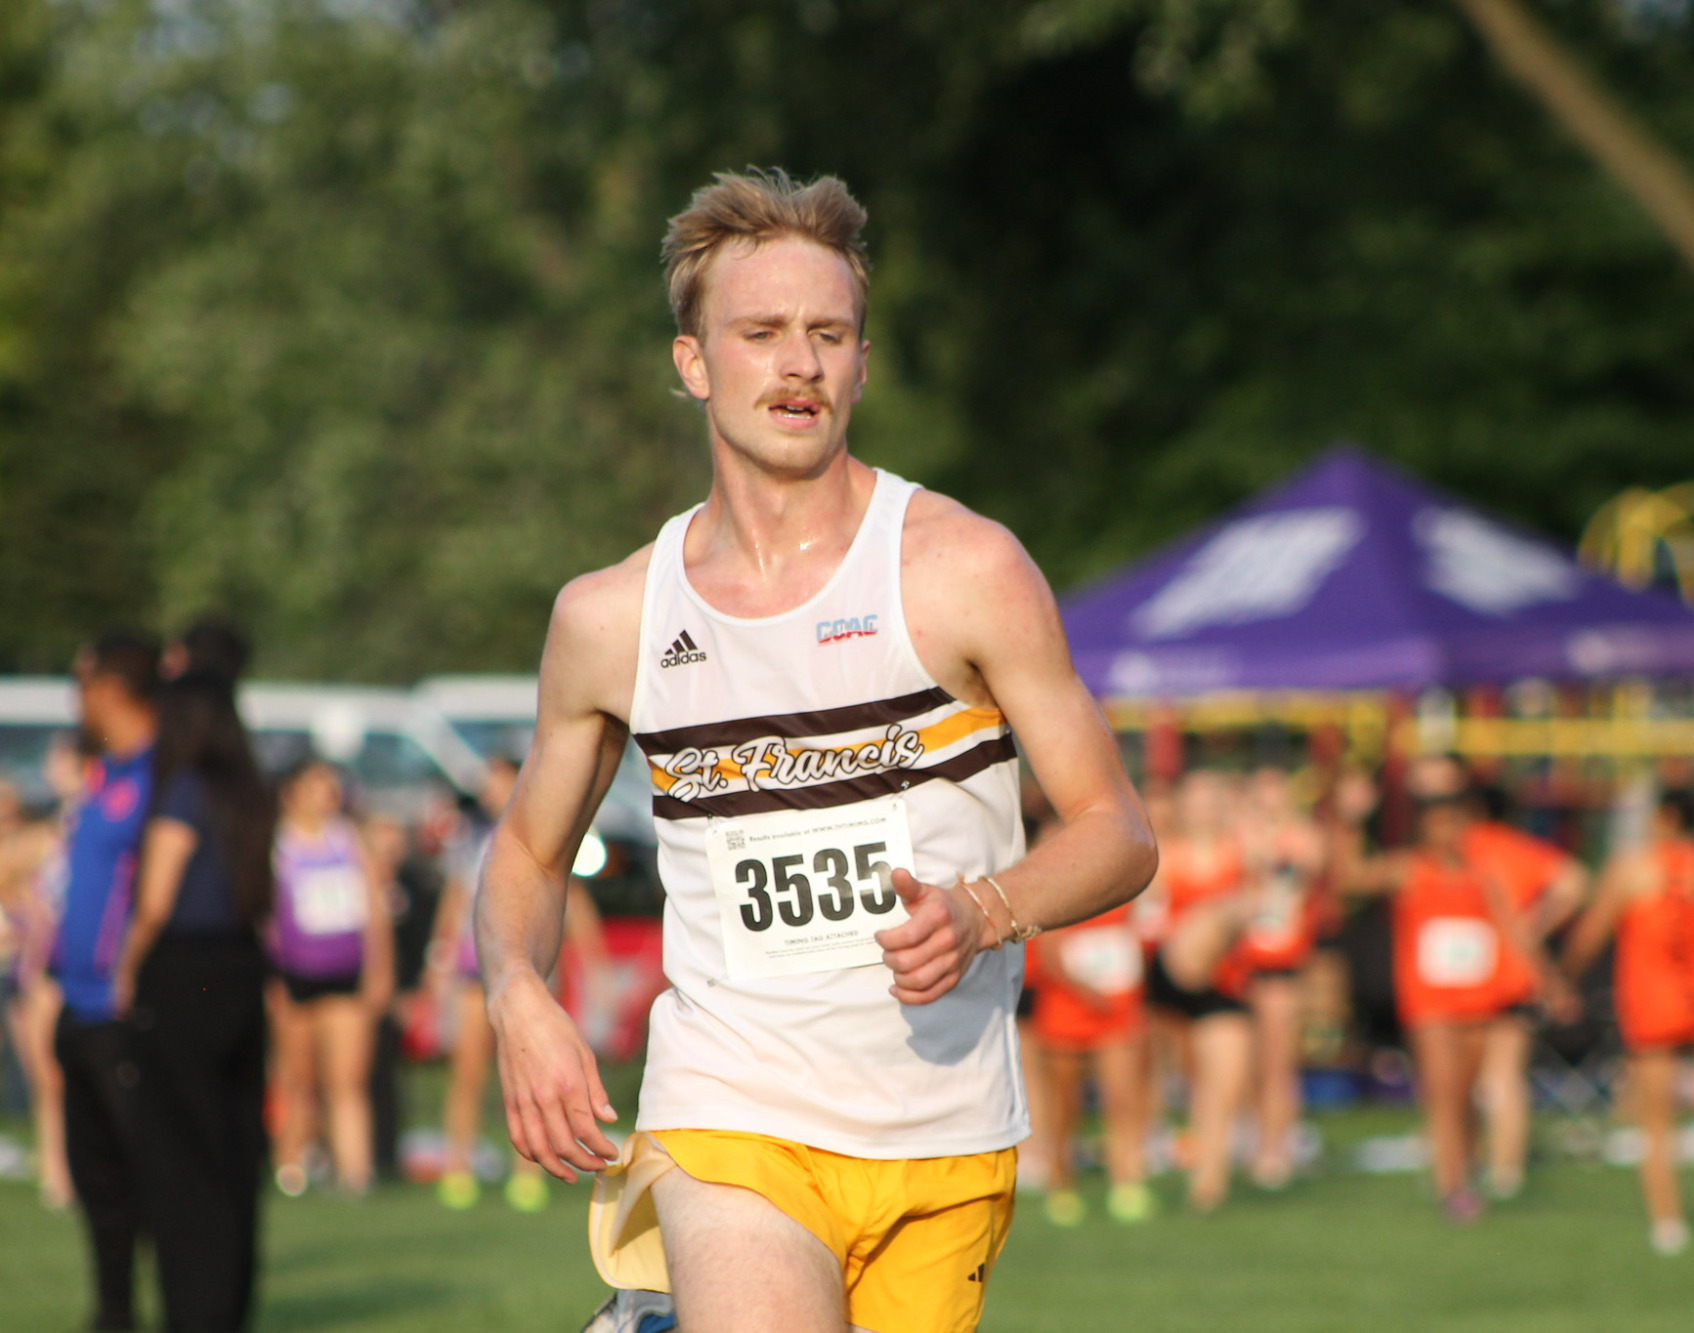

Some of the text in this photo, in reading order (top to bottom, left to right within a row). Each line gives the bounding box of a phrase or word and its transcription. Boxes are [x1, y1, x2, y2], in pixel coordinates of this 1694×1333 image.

[660, 651, 707, 668] adidas
[665, 724, 923, 801] St. Francis
[735, 841, 897, 932] 3535
[811, 934, 824, 942] TAG
[826, 930, 859, 941] ATTACHED
